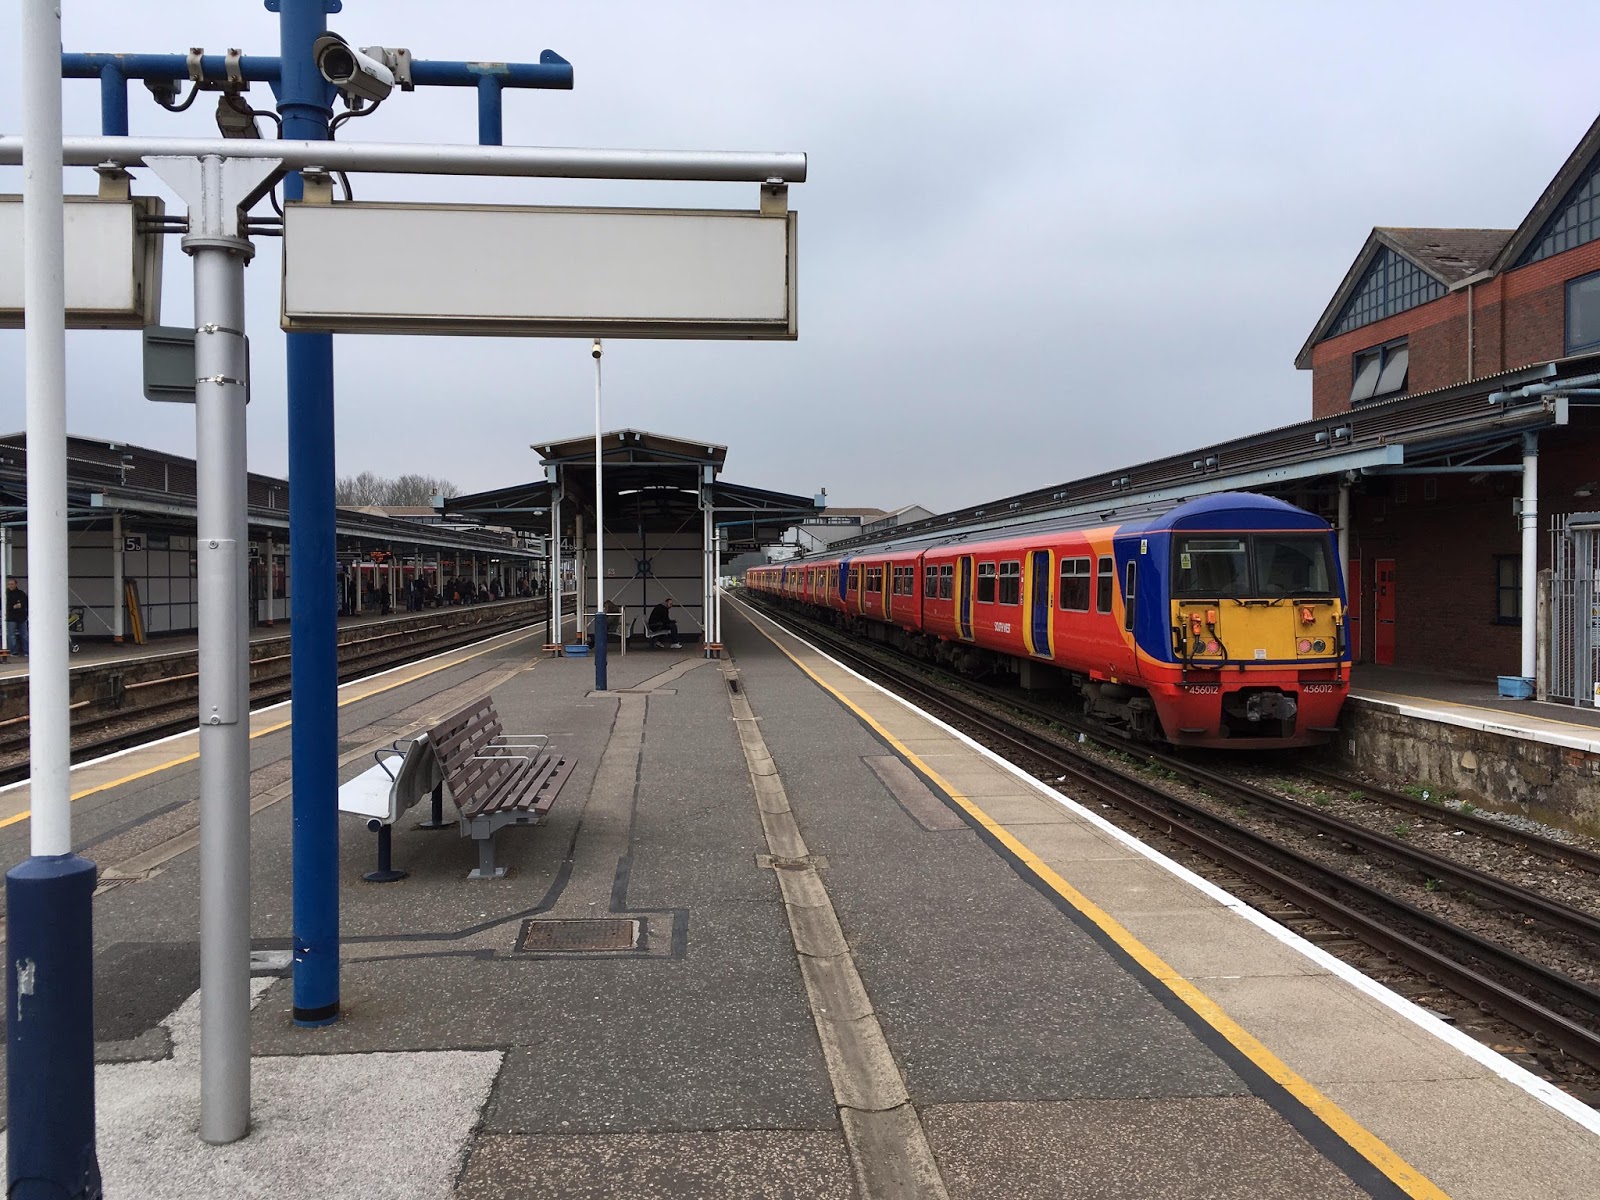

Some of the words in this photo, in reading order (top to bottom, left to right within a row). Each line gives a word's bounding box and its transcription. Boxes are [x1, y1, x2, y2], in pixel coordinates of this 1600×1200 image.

[126, 538, 141, 551] 5b
[1189, 685, 1219, 695] 456012
[1303, 684, 1333, 693] 456012
